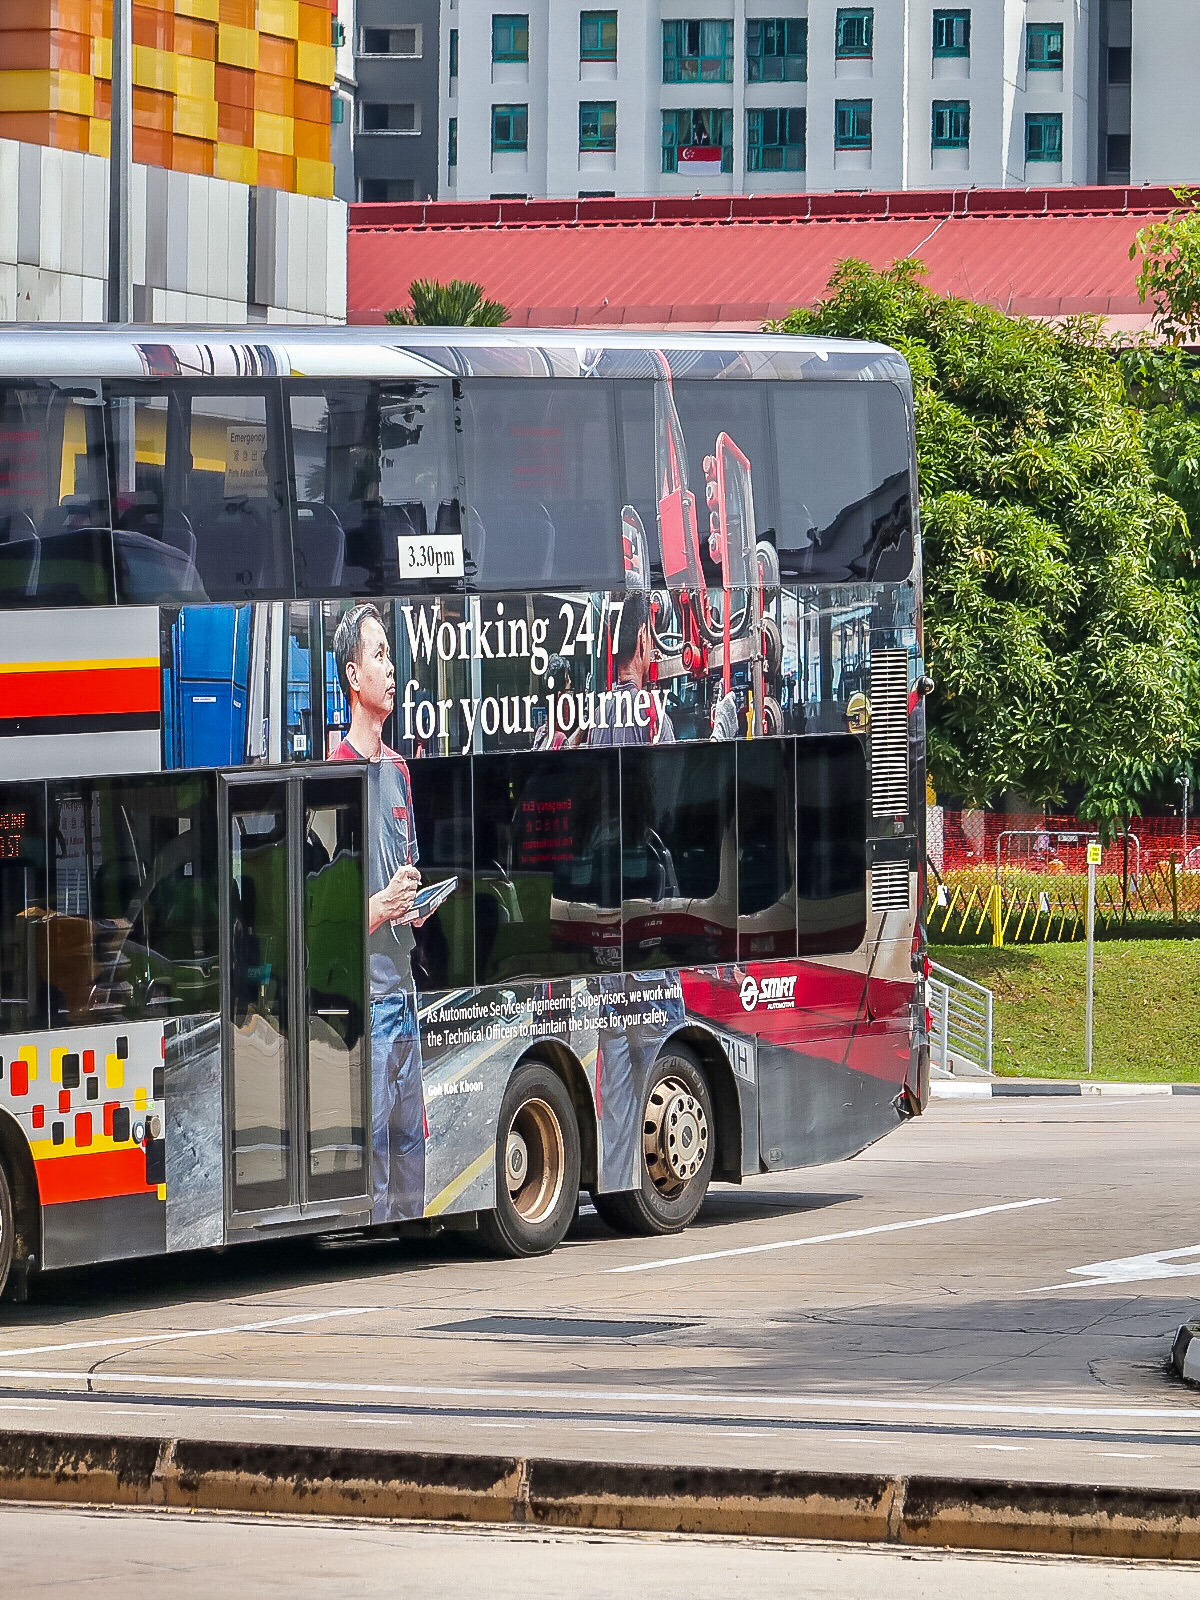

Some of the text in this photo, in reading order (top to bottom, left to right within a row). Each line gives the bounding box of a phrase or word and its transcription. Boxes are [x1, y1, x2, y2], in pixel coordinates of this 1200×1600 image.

[230, 432, 266, 445] Emergency
[408, 545, 455, 574] 3.30pm
[400, 601, 625, 676] Working 24/7
[402, 676, 671, 756] for your journey
[426, 983, 683, 1024] As Automotive Services Engineering Supervisors, we work with
[758, 975, 798, 999] SMRT
[427, 1008, 669, 1047] the Technical Officers to maintain the buses for your safety.
[443, 1082, 459, 1096] Kok
[460, 1080, 484, 1094] Khoon
